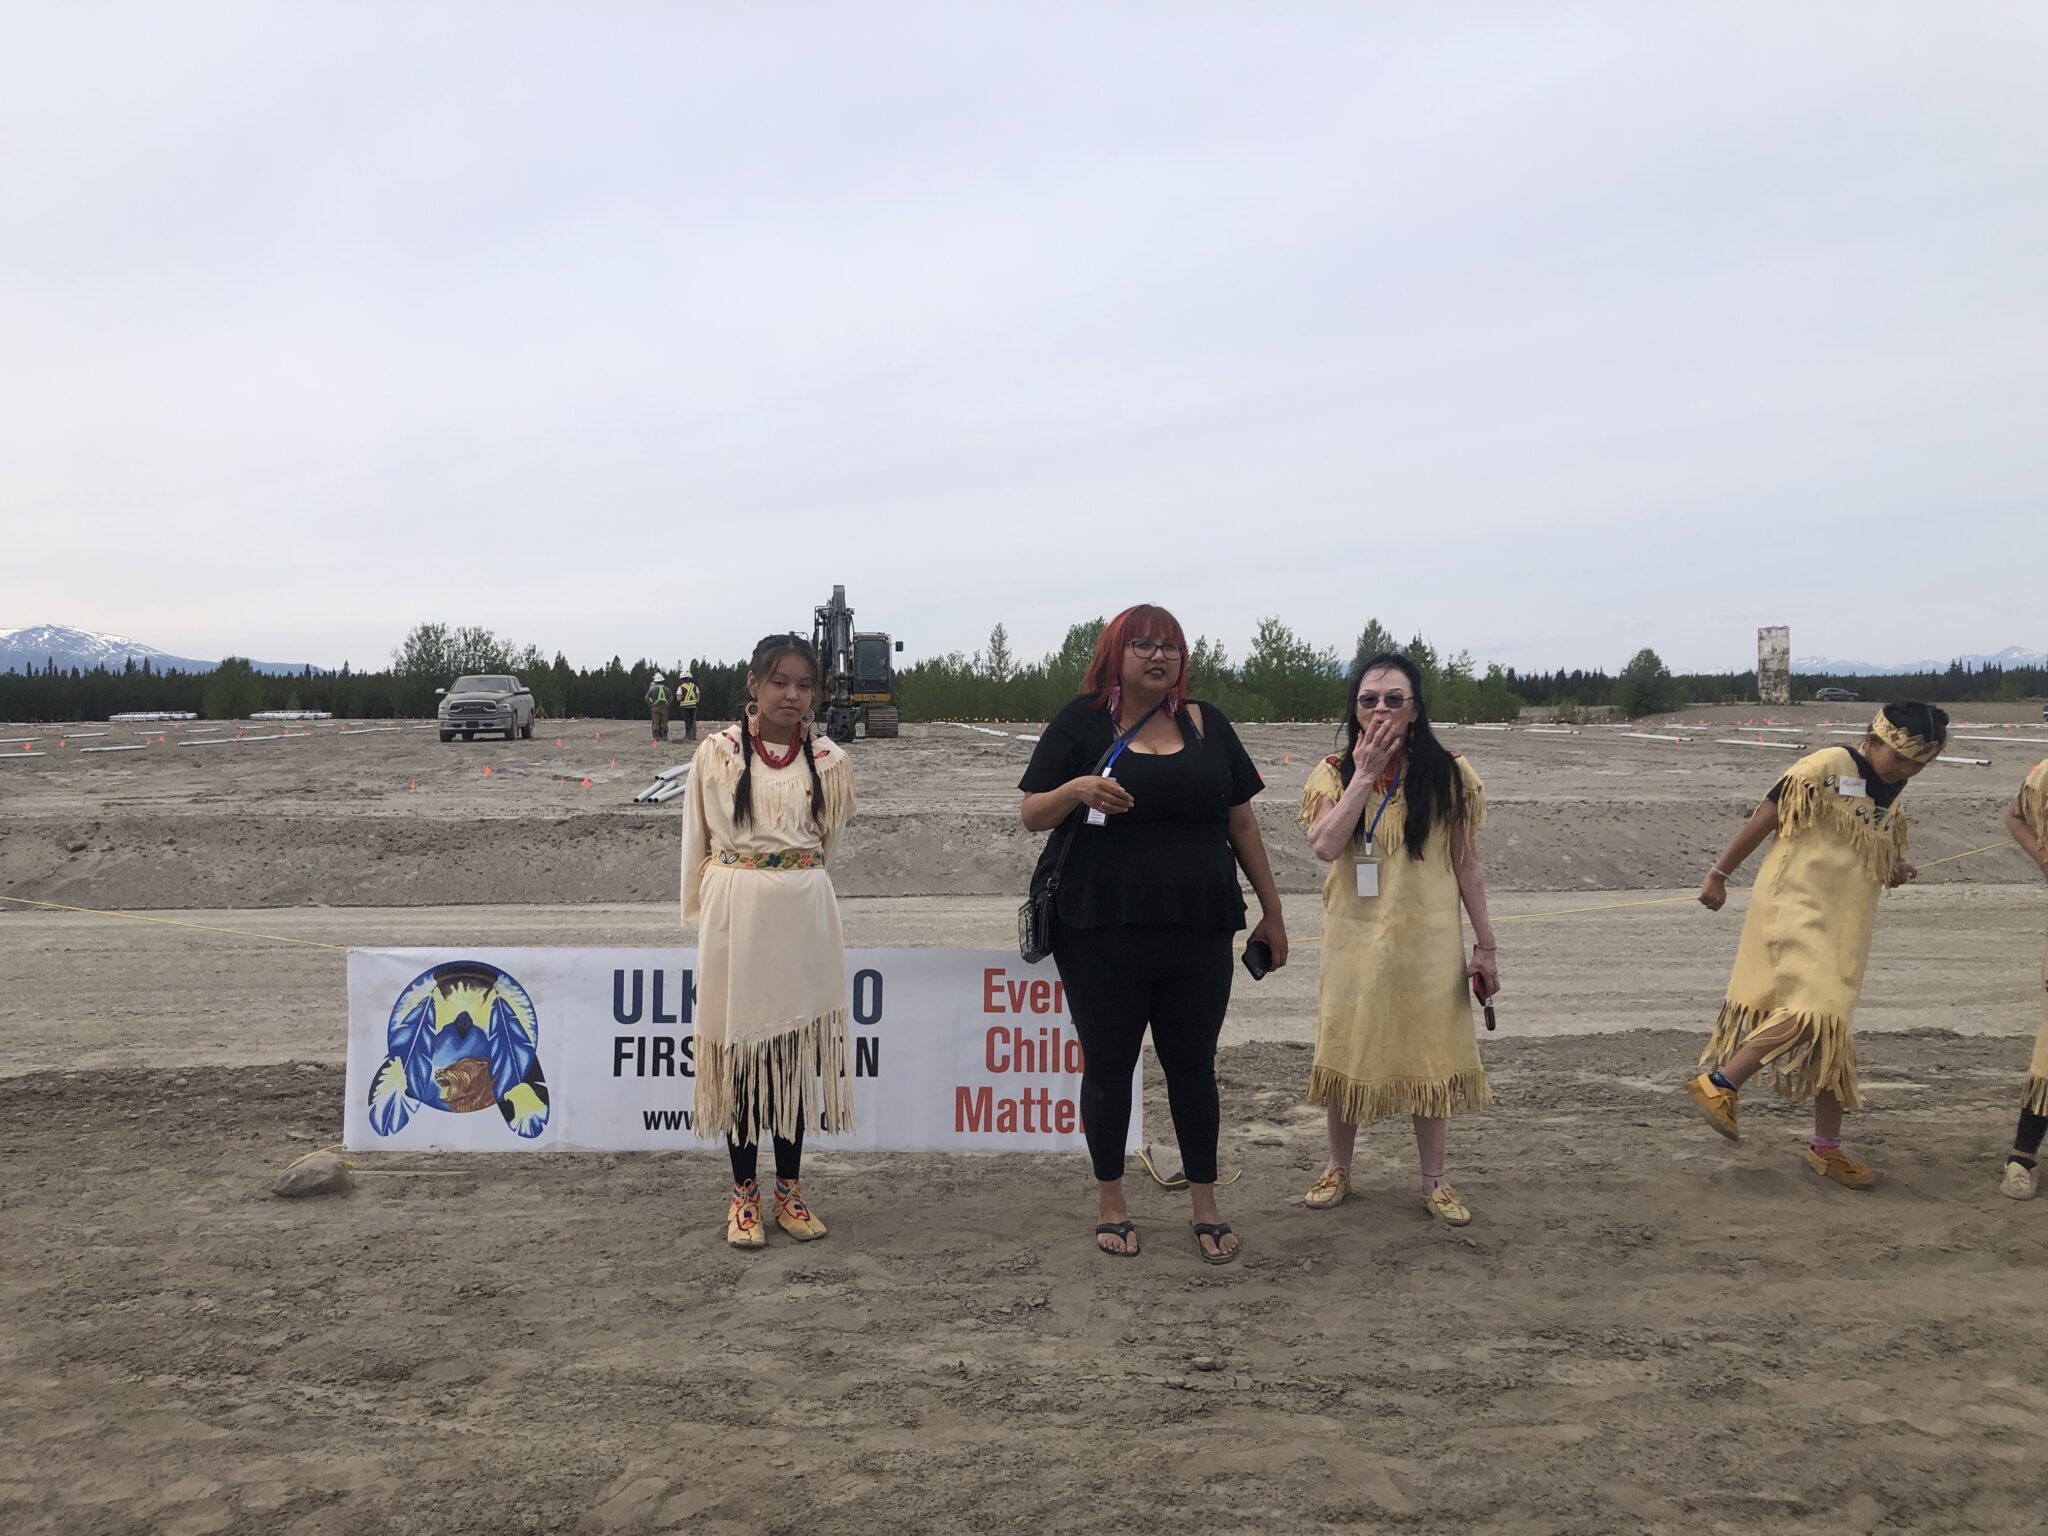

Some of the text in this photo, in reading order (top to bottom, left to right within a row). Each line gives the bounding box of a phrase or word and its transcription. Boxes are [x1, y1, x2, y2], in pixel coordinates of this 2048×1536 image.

[983, 968, 1075, 1025] Ever
[612, 1036, 696, 1077] FIRS
[985, 1026, 1085, 1073] Child
[954, 1086, 1086, 1134] Matte
